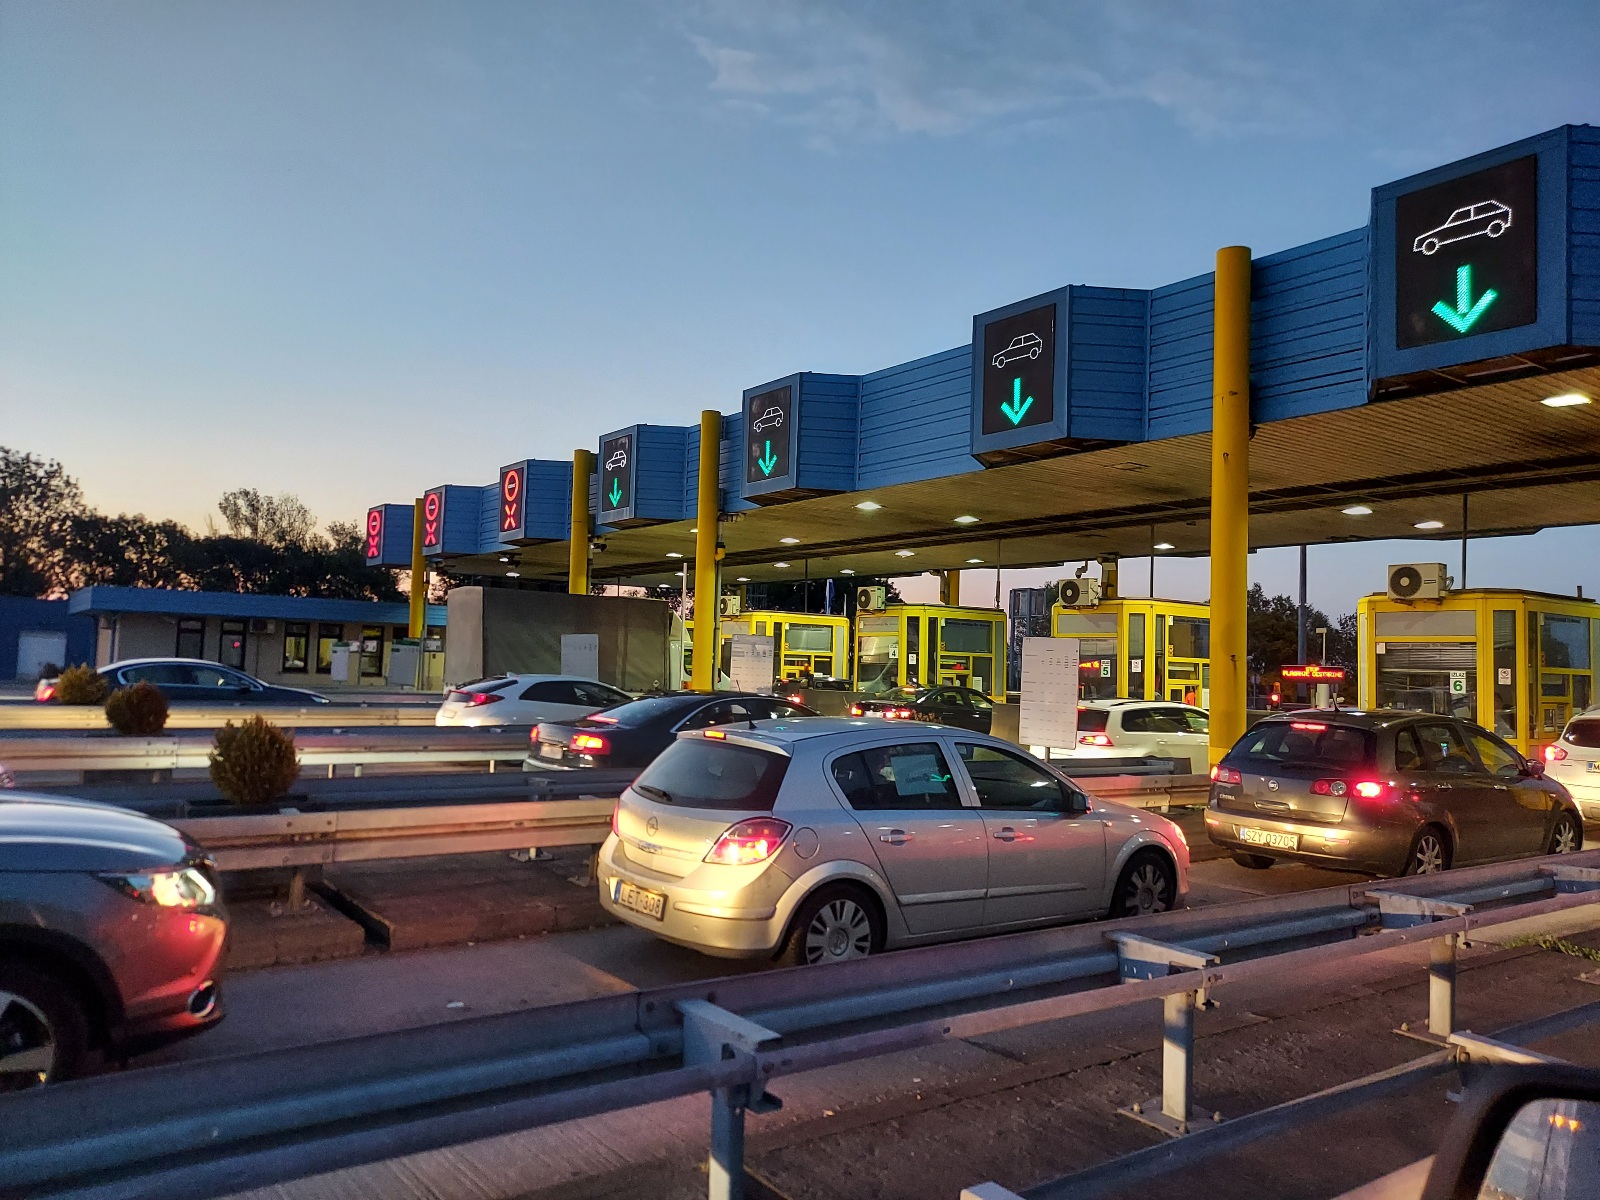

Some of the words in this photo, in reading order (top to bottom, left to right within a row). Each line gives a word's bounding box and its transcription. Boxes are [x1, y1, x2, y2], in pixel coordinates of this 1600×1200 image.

[891, 649, 896, 657] 4
[1102, 666, 1109, 676] 5
[1453, 680, 1463, 692] 6
[1593, 763, 1600, 771] M
[1245, 829, 1263, 843] SZY
[621, 886, 661, 914] LET-308
